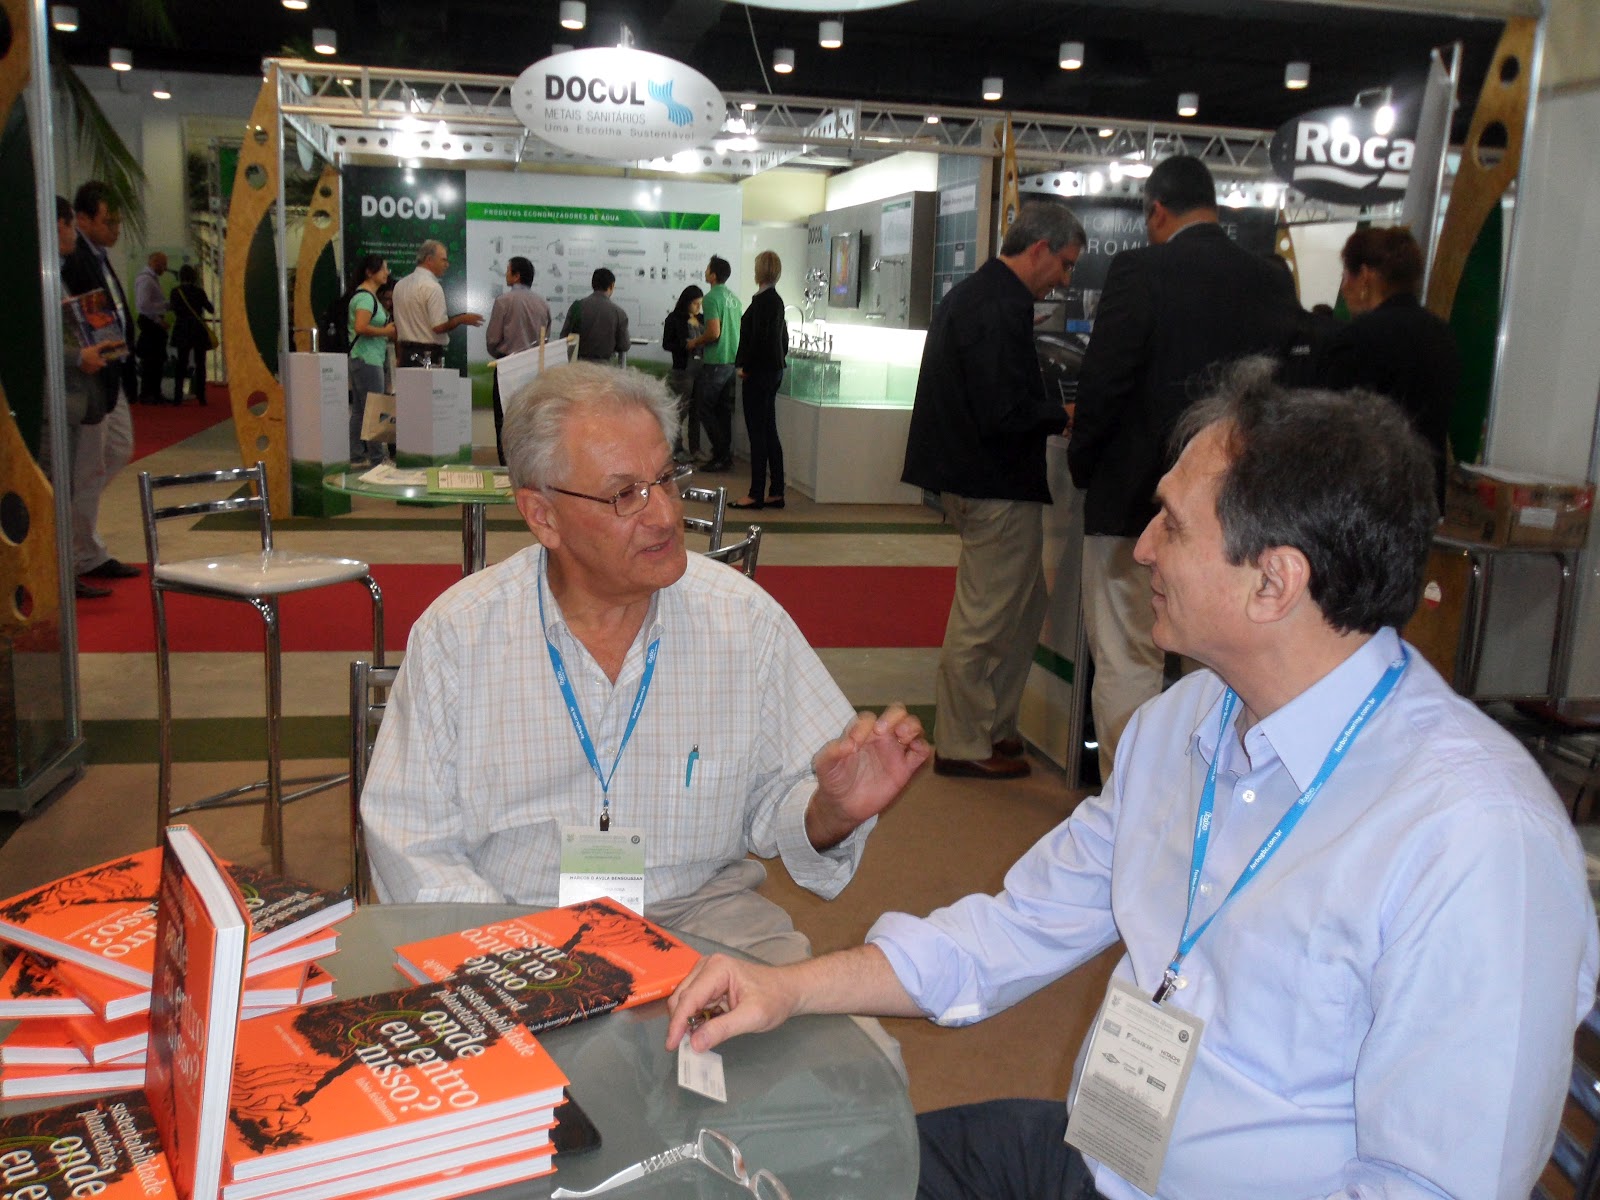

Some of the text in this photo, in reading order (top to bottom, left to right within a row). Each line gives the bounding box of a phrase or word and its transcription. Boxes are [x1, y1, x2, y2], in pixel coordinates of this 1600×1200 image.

[545, 74, 645, 106] DOCOL
[545, 108, 646, 124] METAIS SANITÁRIOS
[545, 123, 695, 140] Uma Escolha Sustentável
[1294, 120, 1416, 170] Roca
[361, 195, 446, 220] DOCOL
[484, 209, 522, 217] PRODUTOS
[523, 211, 588, 220] ECONOMIZADORES
[1334, 697, 1376, 753] forbo-flooring.com.br
[1249, 828, 1283, 870] forbogbc.com.br
[460, 928, 525, 962] entro
[464, 955, 528, 991] onde
[520, 959, 557, 981] eu
[420, 1010, 487, 1060] onde
[456, 984, 536, 1058] sustentabilidade
[355, 1042, 441, 1113] nisso?
[380, 1021, 421, 1049] eu
[407, 1047, 479, 1109] entro
[0, 1150, 39, 1185] eu
[50, 1136, 117, 1199] onde
[109, 1102, 167, 1196] sustentabilidade
